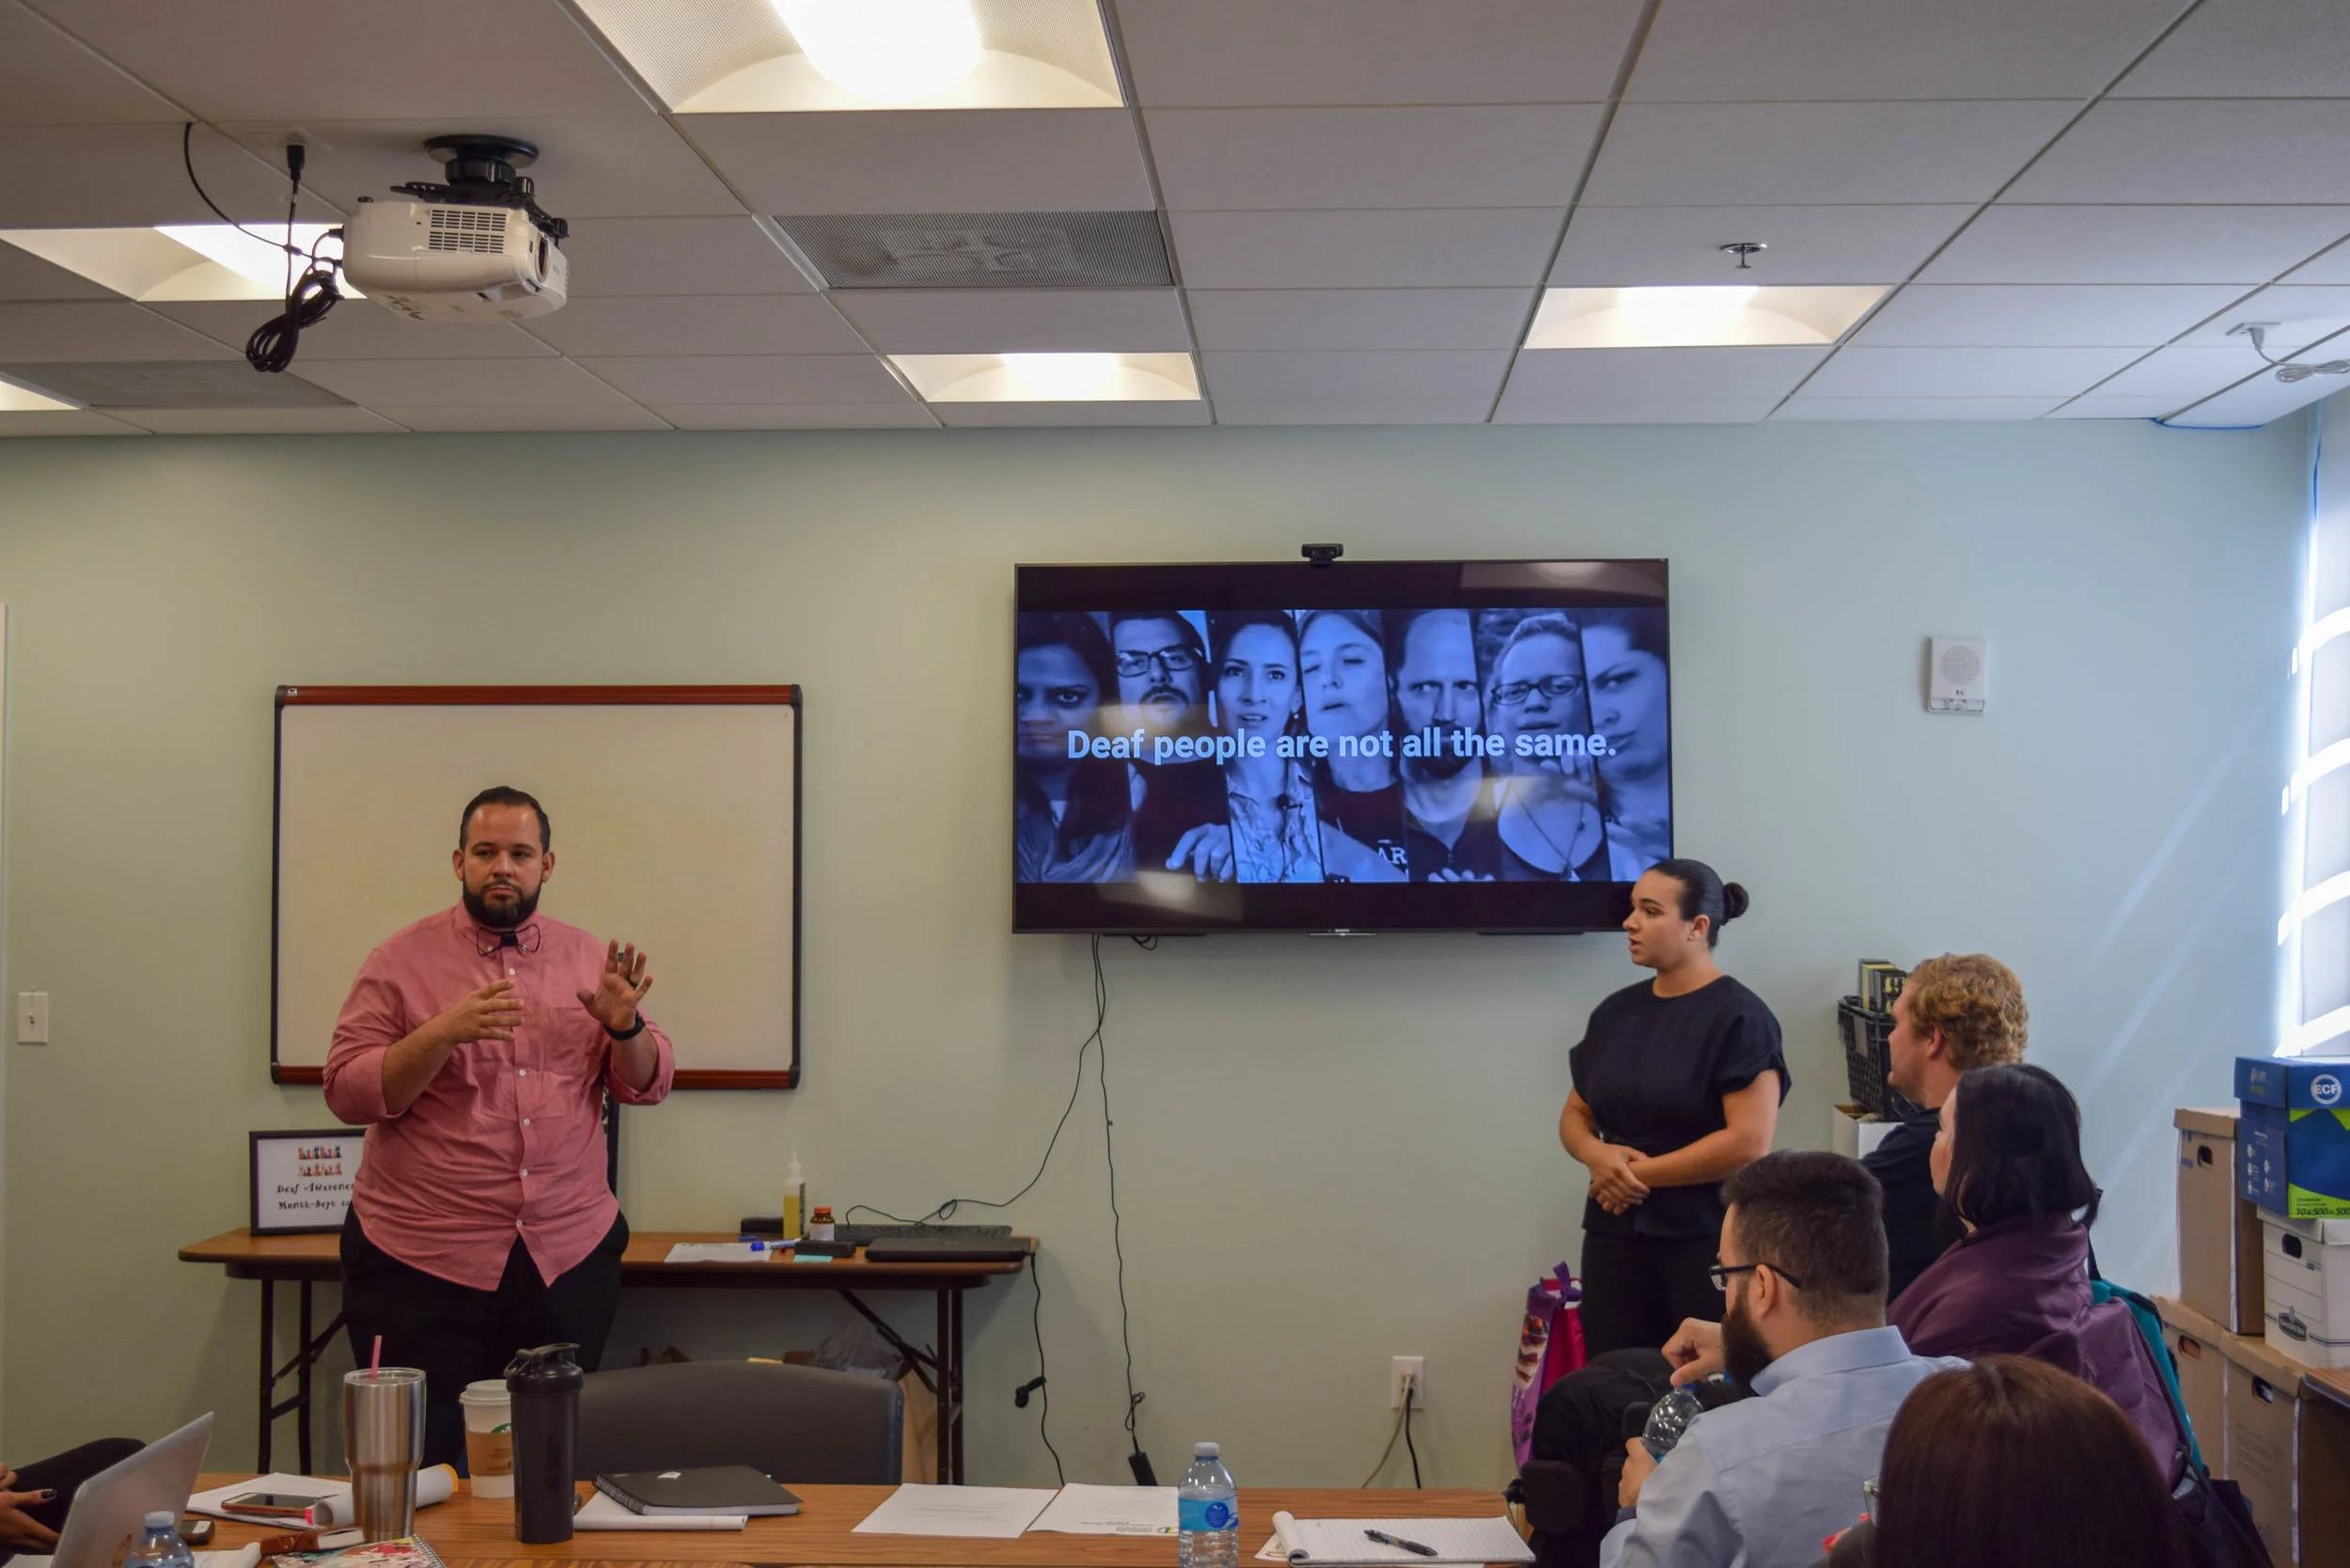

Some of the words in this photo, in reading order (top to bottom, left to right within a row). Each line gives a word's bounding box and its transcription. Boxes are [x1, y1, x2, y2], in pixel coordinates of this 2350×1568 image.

[1068, 729, 1145, 759] Deaf
[1154, 729, 1266, 765] people
[1276, 735, 1328, 758] are
[1339, 729, 1393, 757] not
[1402, 727, 1441, 757] all
[1451, 727, 1504, 757] the
[1514, 733, 1616, 757] same.
